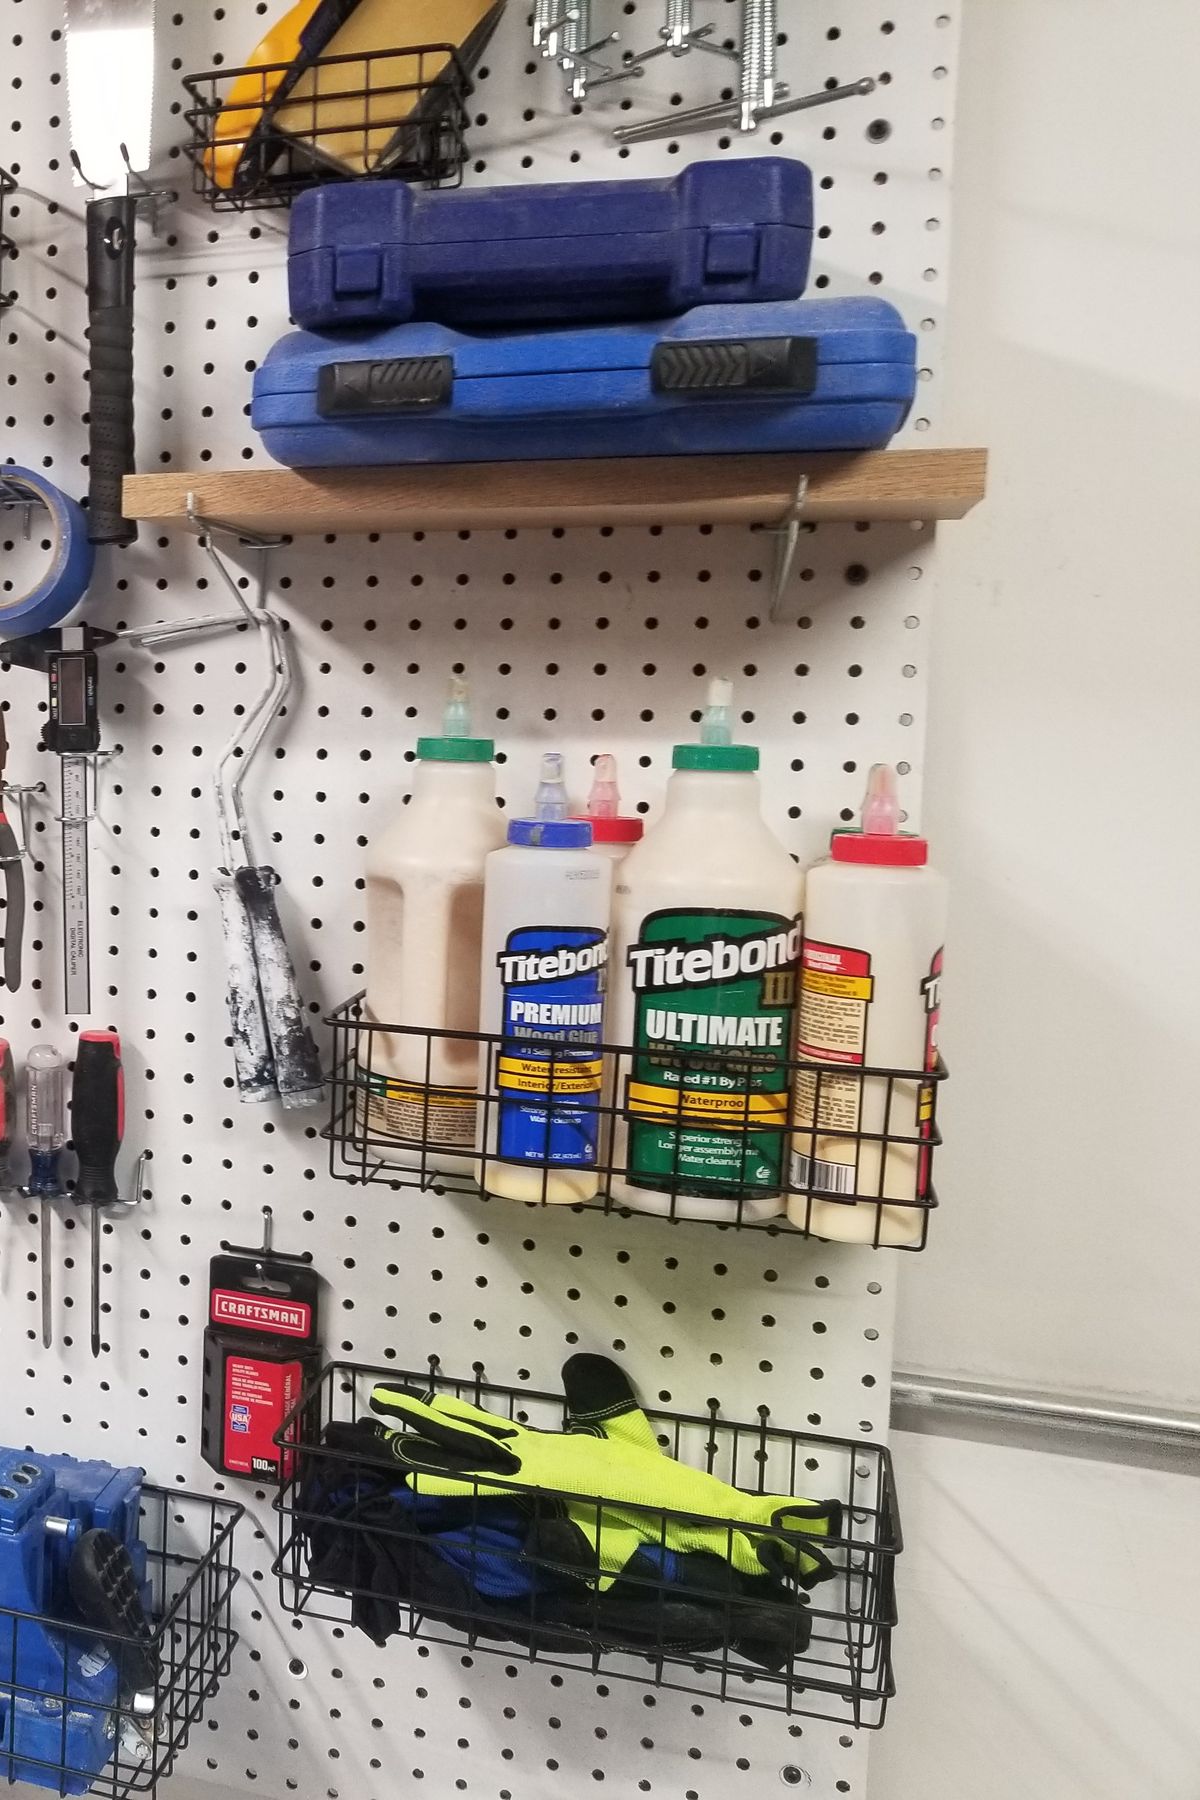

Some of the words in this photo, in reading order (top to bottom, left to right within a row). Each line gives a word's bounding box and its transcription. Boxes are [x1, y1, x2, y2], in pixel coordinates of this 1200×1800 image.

[69, 927, 77, 950] DIGITAL
[500, 938, 609, 983] Titebon
[629, 919, 802, 988] Titebond
[763, 971, 795, 1005] III
[510, 1000, 603, 1026] PREMIUM
[645, 1008, 783, 1047] ULTIMATE
[663, 1070, 701, 1084] Raed
[701, 1075, 717, 1086] #1
[719, 1076, 736, 1089] By
[668, 1131, 711, 1144] Sperior
[692, 1146, 737, 1157] assembly
[221, 1300, 299, 1326] CRAFTSMAN
[231, 1413, 248, 1422] USA
